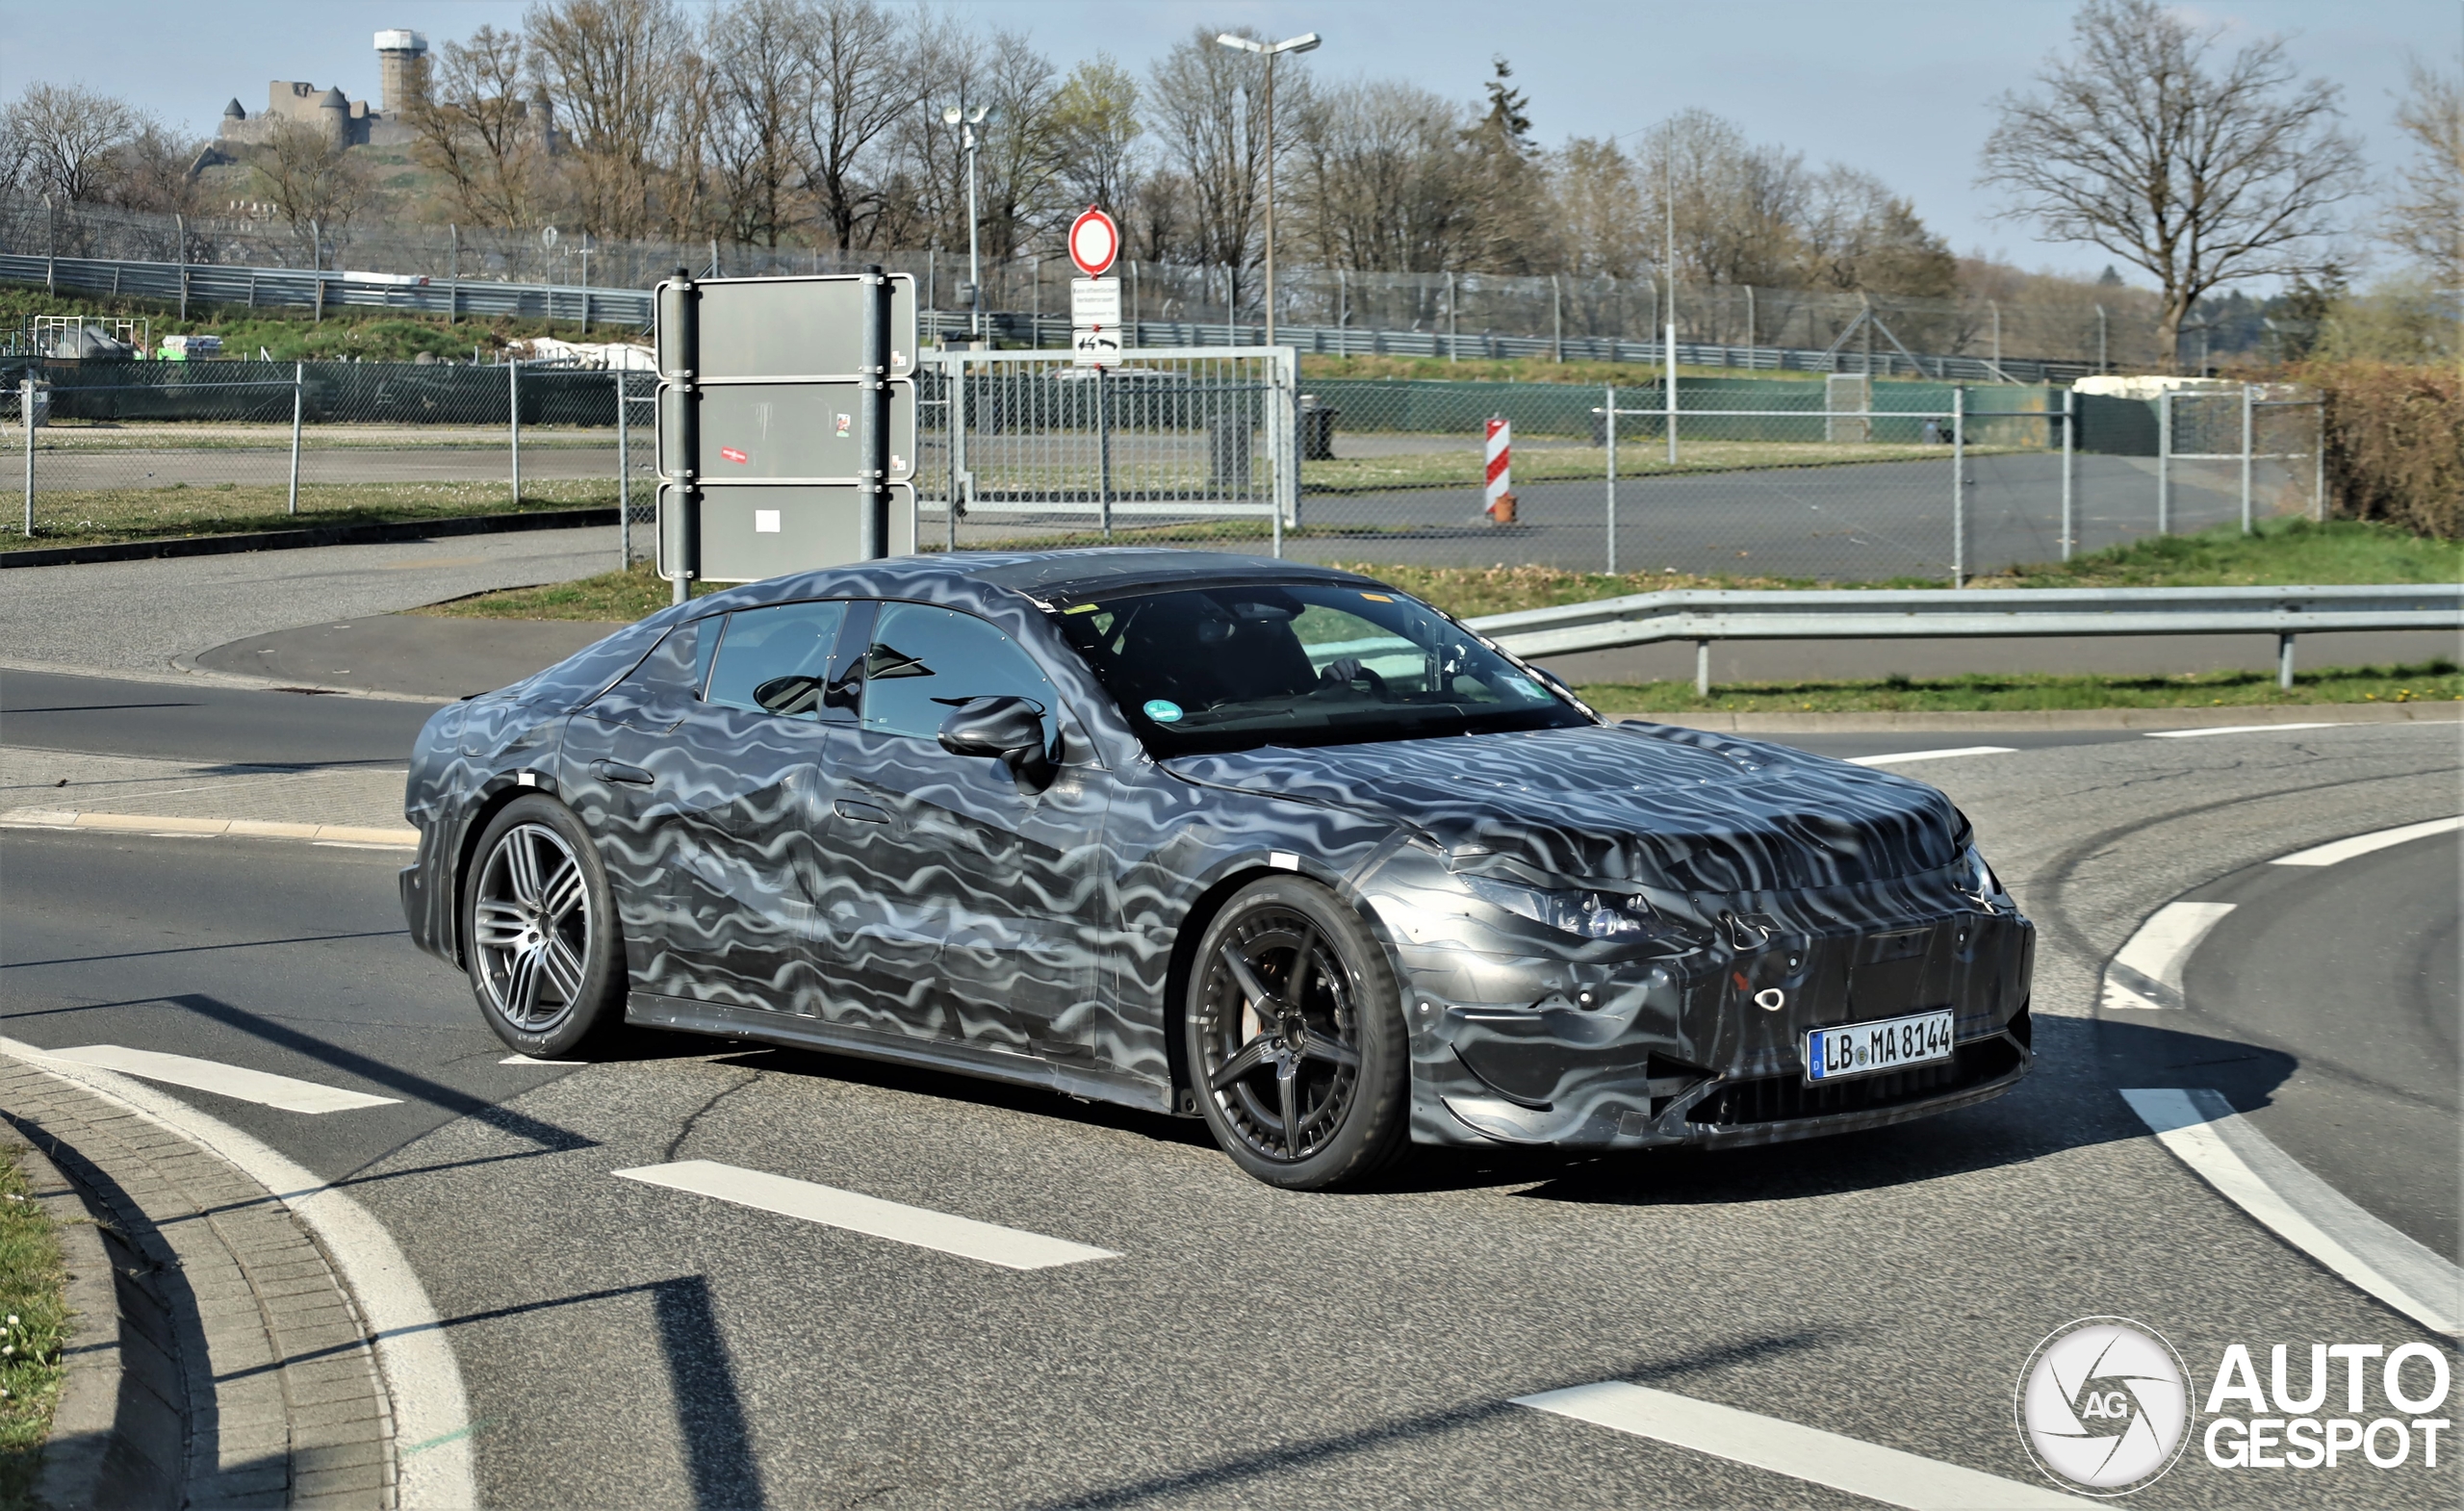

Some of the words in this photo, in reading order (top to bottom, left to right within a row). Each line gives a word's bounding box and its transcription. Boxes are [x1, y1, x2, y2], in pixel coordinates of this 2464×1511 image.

[1825, 1034, 1853, 1071] LB
[1870, 1027, 1897, 1064] MA
[1901, 1018, 1950, 1059] 8144
[1812, 1060, 1820, 1071] D
